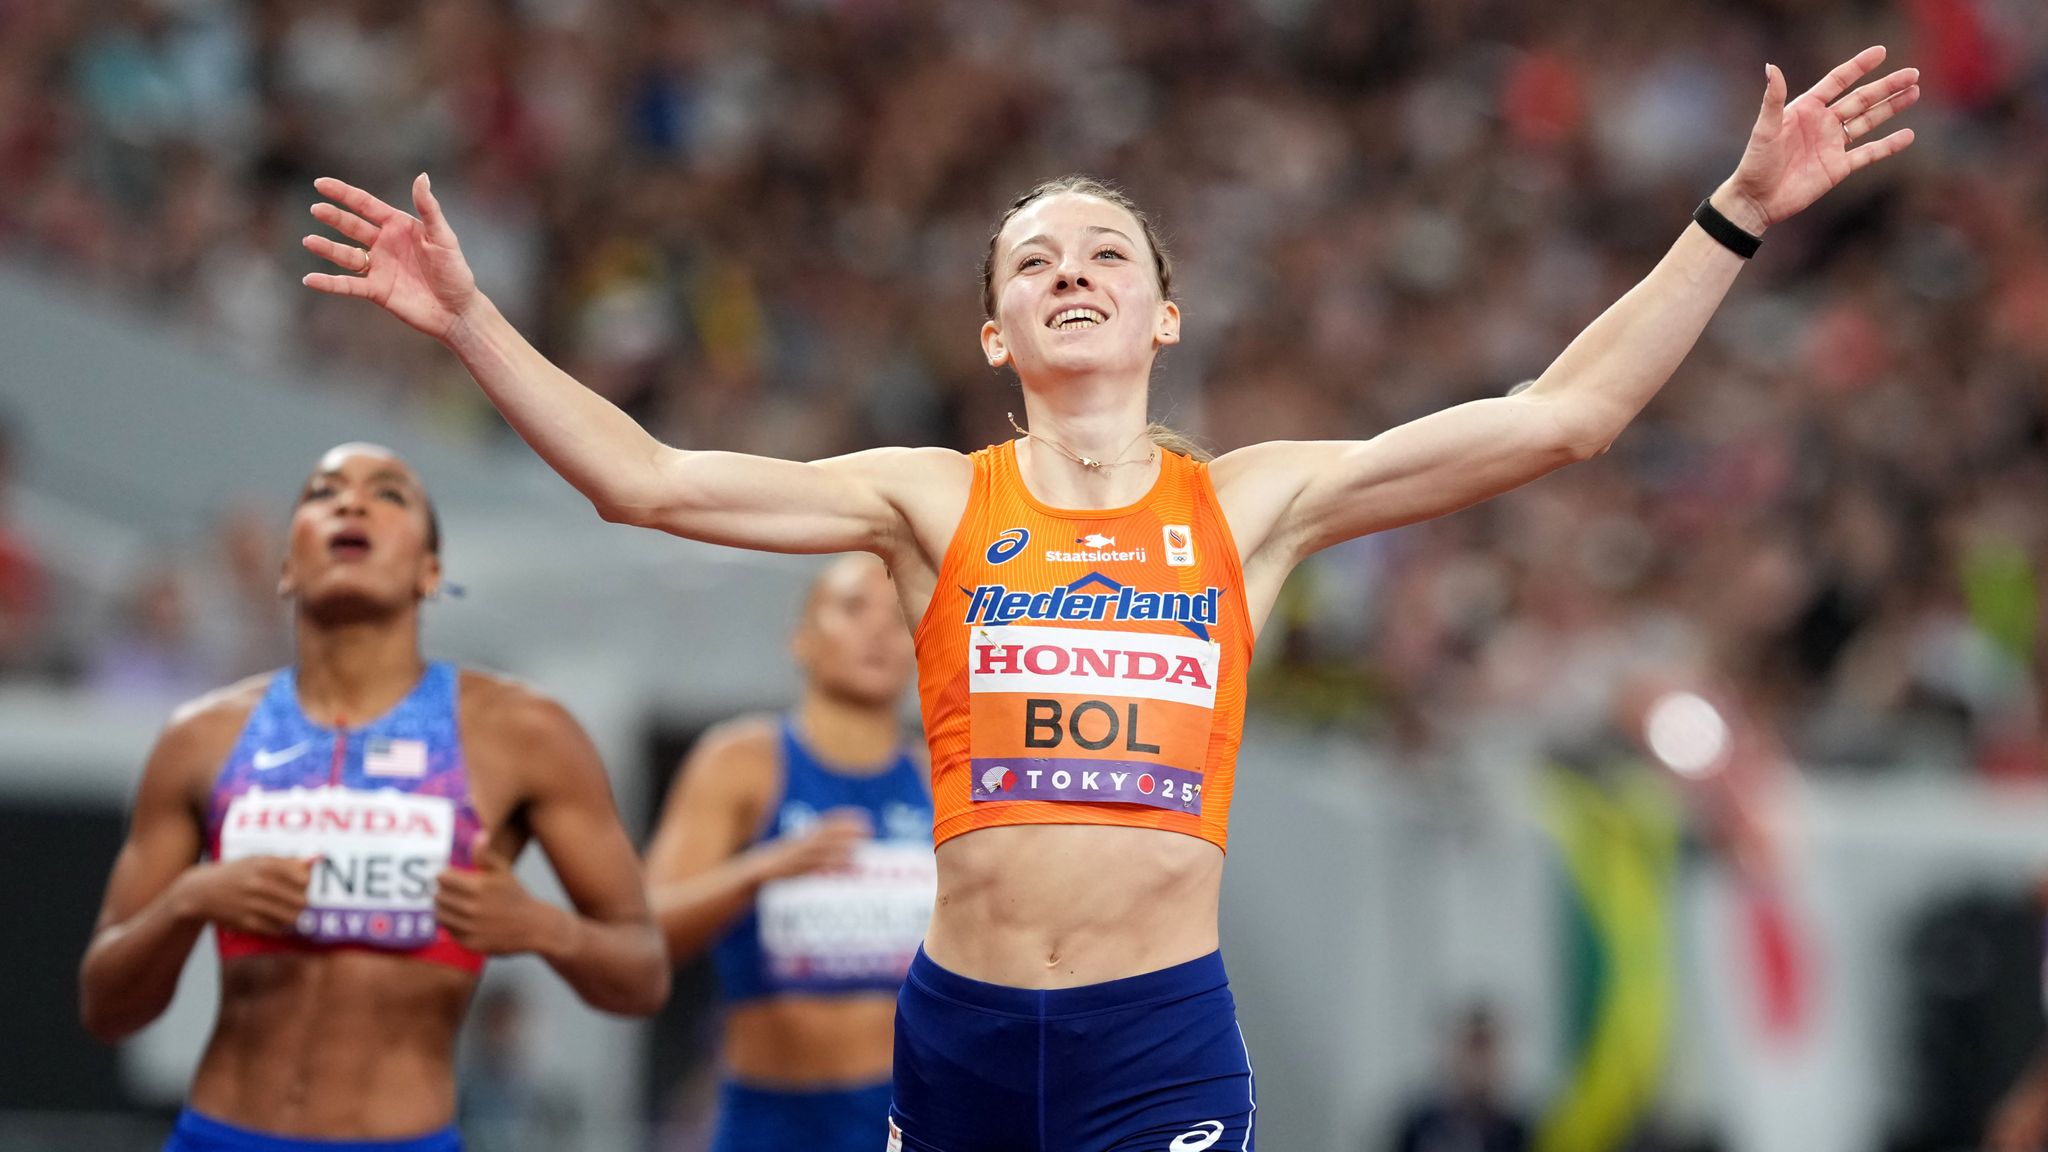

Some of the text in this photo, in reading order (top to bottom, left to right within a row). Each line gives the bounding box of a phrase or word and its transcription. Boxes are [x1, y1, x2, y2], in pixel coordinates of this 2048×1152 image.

[1045, 548, 1147, 563] Staatsloterij
[974, 645, 1212, 690] HONDA
[1025, 699, 1160, 754] BOL
[1161, 779, 1193, 802] 25
[236, 807, 436, 837] HONDA
[319, 856, 428, 900] NES
